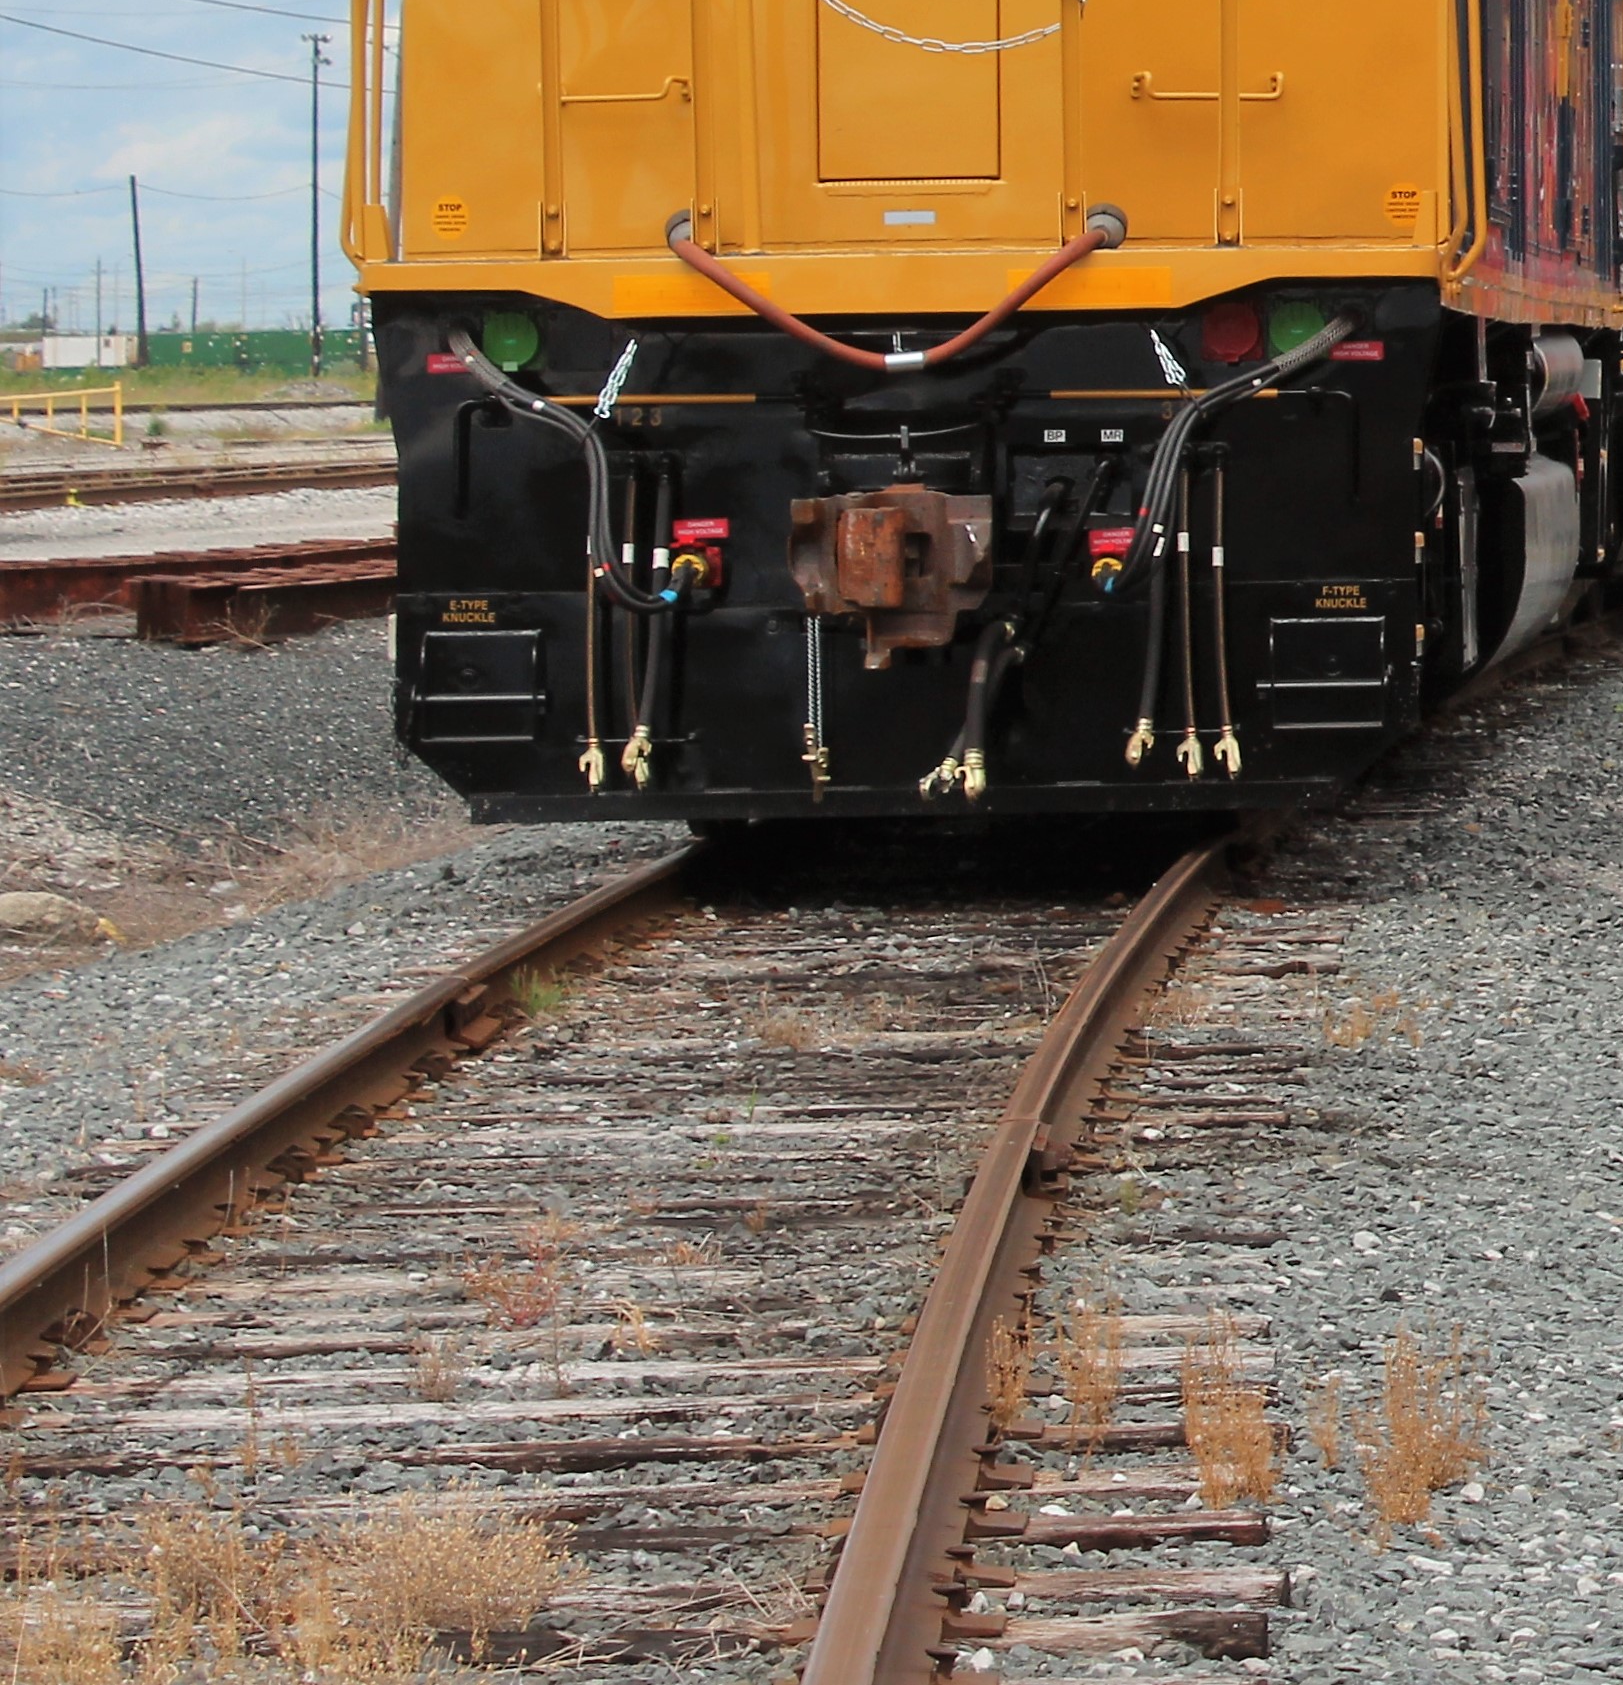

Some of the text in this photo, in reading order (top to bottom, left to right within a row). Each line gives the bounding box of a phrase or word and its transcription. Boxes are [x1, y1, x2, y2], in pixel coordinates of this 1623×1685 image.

[1391, 191, 1417, 199] STOP
[438, 203, 462, 212] STOP
[1047, 430, 1063, 441] BP
[1103, 429, 1121, 440] MR
[1322, 585, 1360, 596] F-TYPE
[449, 600, 488, 610] E-TYPE
[1315, 597, 1367, 608] KNUCKLE
[442, 612, 496, 622] KNUCKLE
